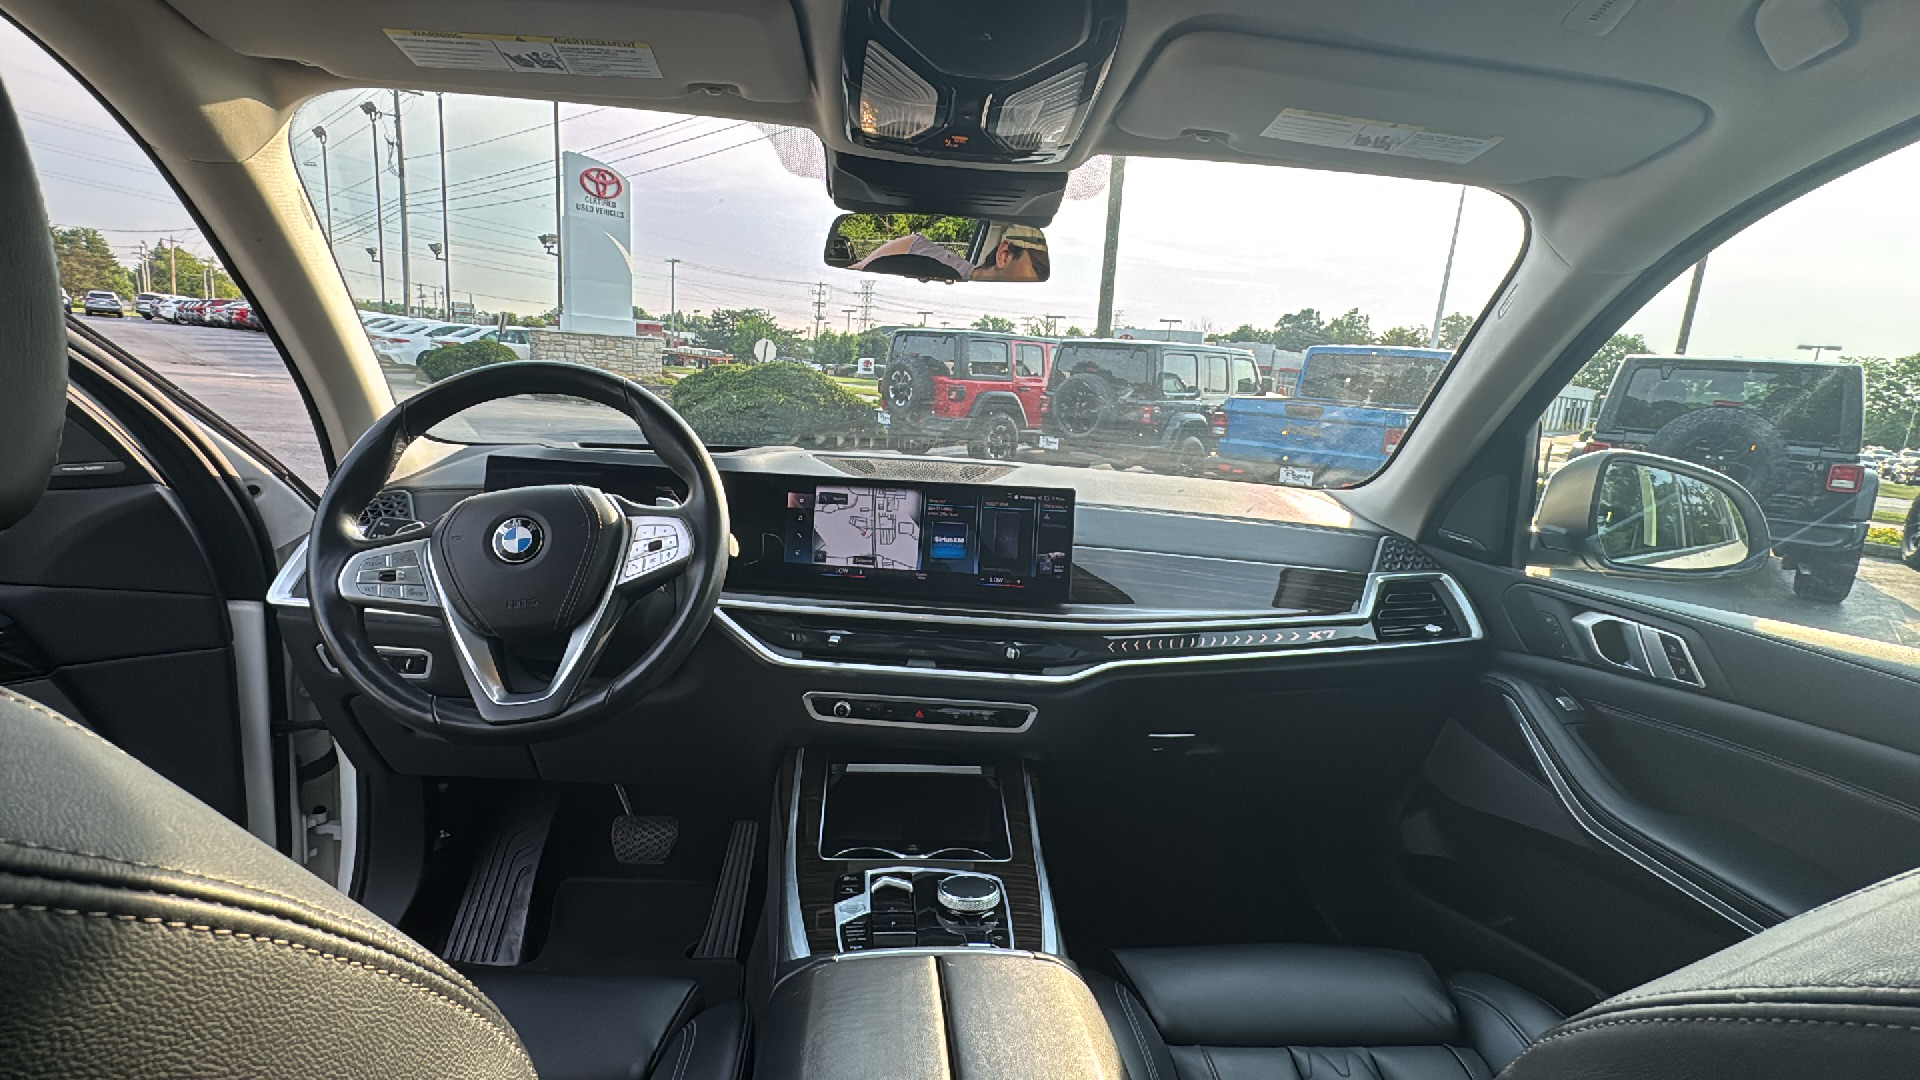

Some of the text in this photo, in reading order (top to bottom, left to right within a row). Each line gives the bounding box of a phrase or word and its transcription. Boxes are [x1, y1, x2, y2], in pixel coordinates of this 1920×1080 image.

[411, 30, 463, 39] WARNING
[584, 195, 617, 209] CERTIFIED
[575, 202, 625, 219] USED VEHICLES
[1306, 629, 1337, 641] X7
